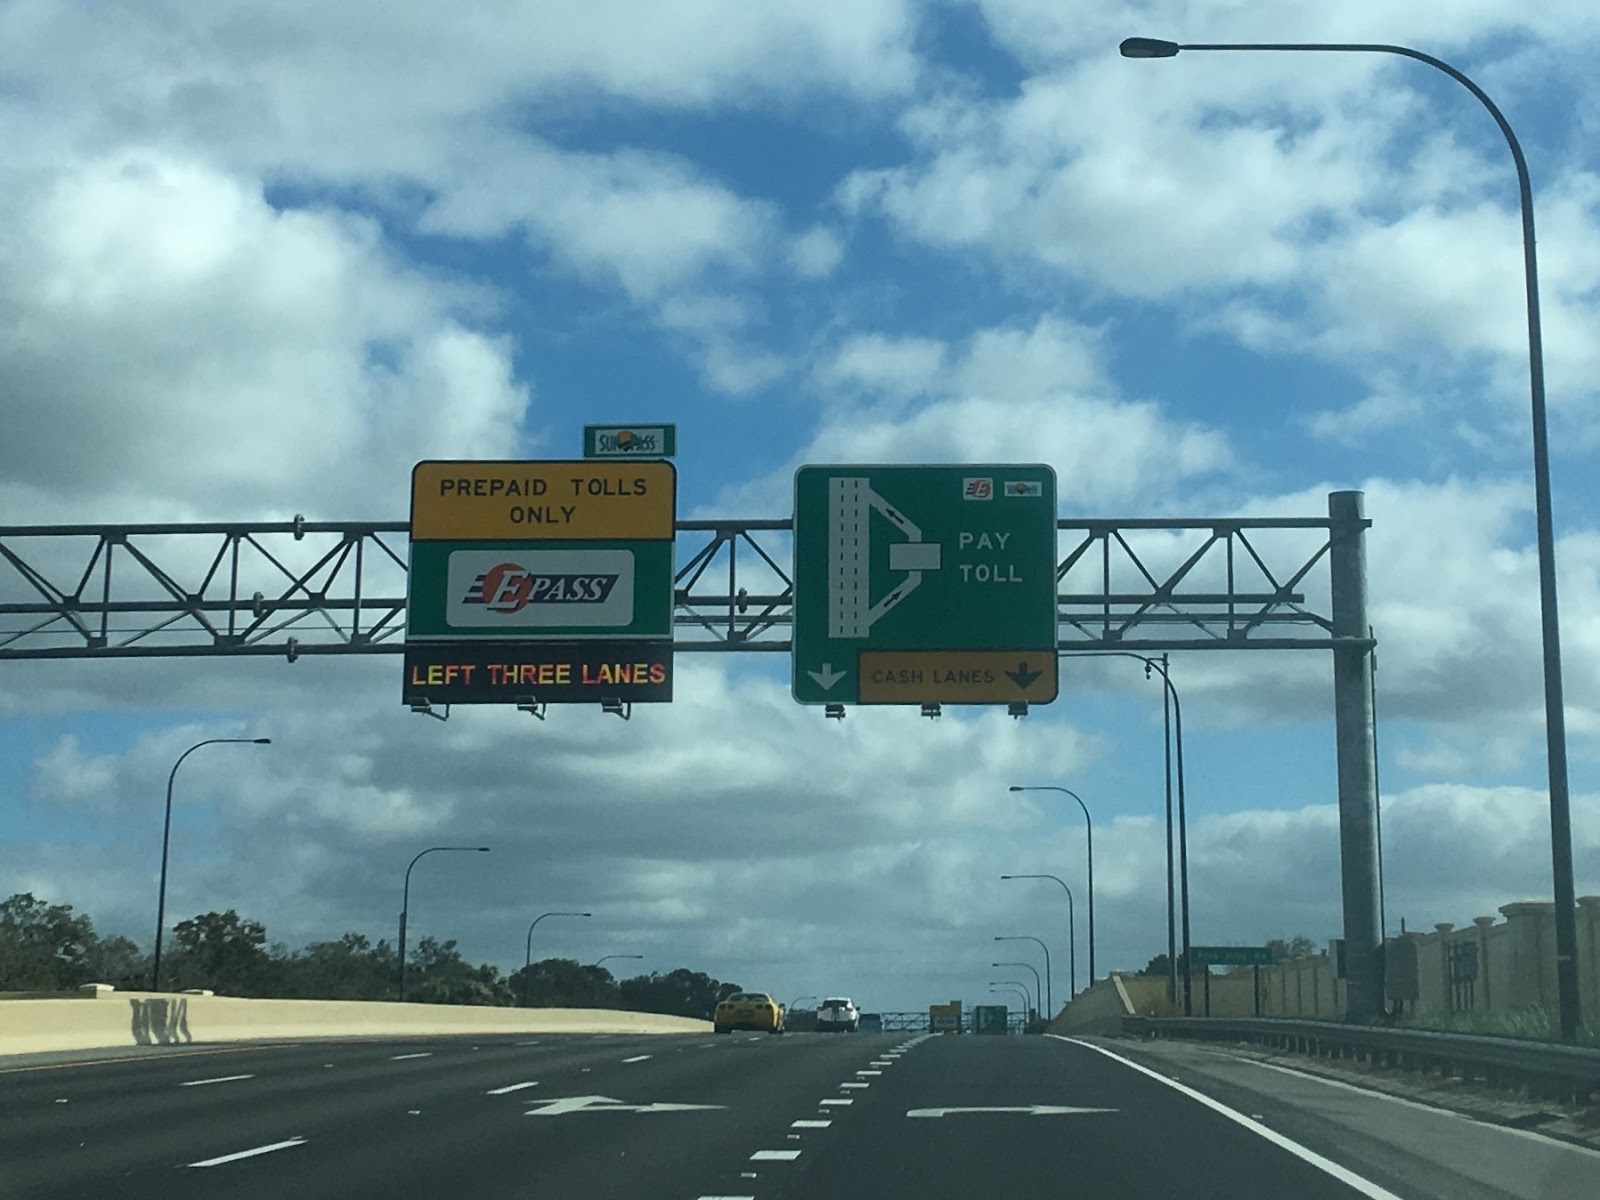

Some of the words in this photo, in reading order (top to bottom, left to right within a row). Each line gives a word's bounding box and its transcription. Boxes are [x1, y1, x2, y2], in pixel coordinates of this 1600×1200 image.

[440, 479, 547, 496] PREPAID
[571, 478, 647, 495] TOLLS
[510, 506, 577, 524] ONLY
[959, 533, 1011, 550] PAY
[959, 564, 1023, 583] TOLL
[411, 664, 476, 686] LEFT
[487, 664, 572, 685] THREE
[581, 663, 666, 685] LANES
[872, 669, 923, 685] CASH
[933, 669, 995, 685] LANES
